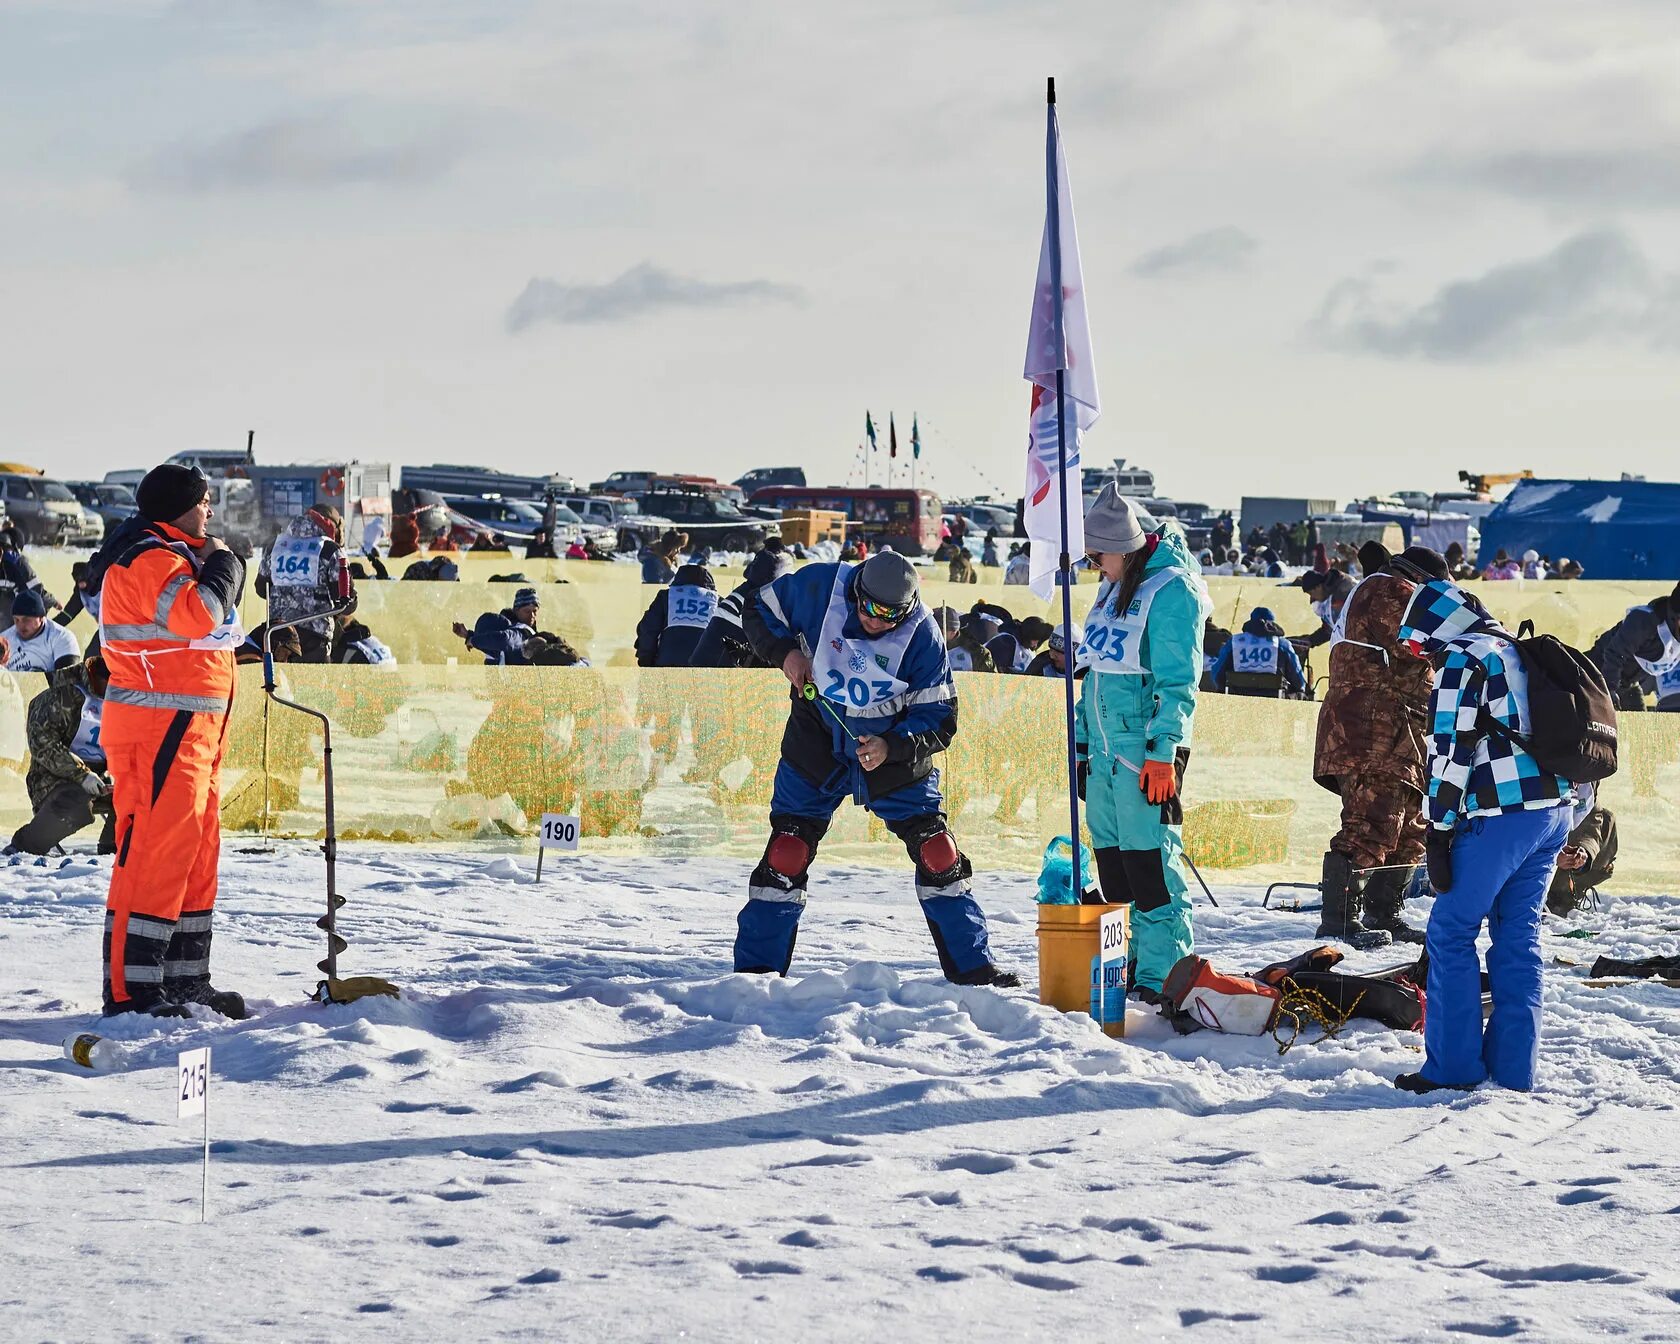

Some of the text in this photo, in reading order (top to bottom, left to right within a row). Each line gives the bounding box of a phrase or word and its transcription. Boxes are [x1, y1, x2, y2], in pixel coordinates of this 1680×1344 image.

[276, 555, 310, 574] 164
[675, 598, 709, 617] 152
[1239, 647, 1272, 664] 140
[823, 668, 895, 708] 203
[544, 820, 575, 842] 190
[1103, 920, 1123, 950] 203
[181, 1063, 206, 1101] 215
